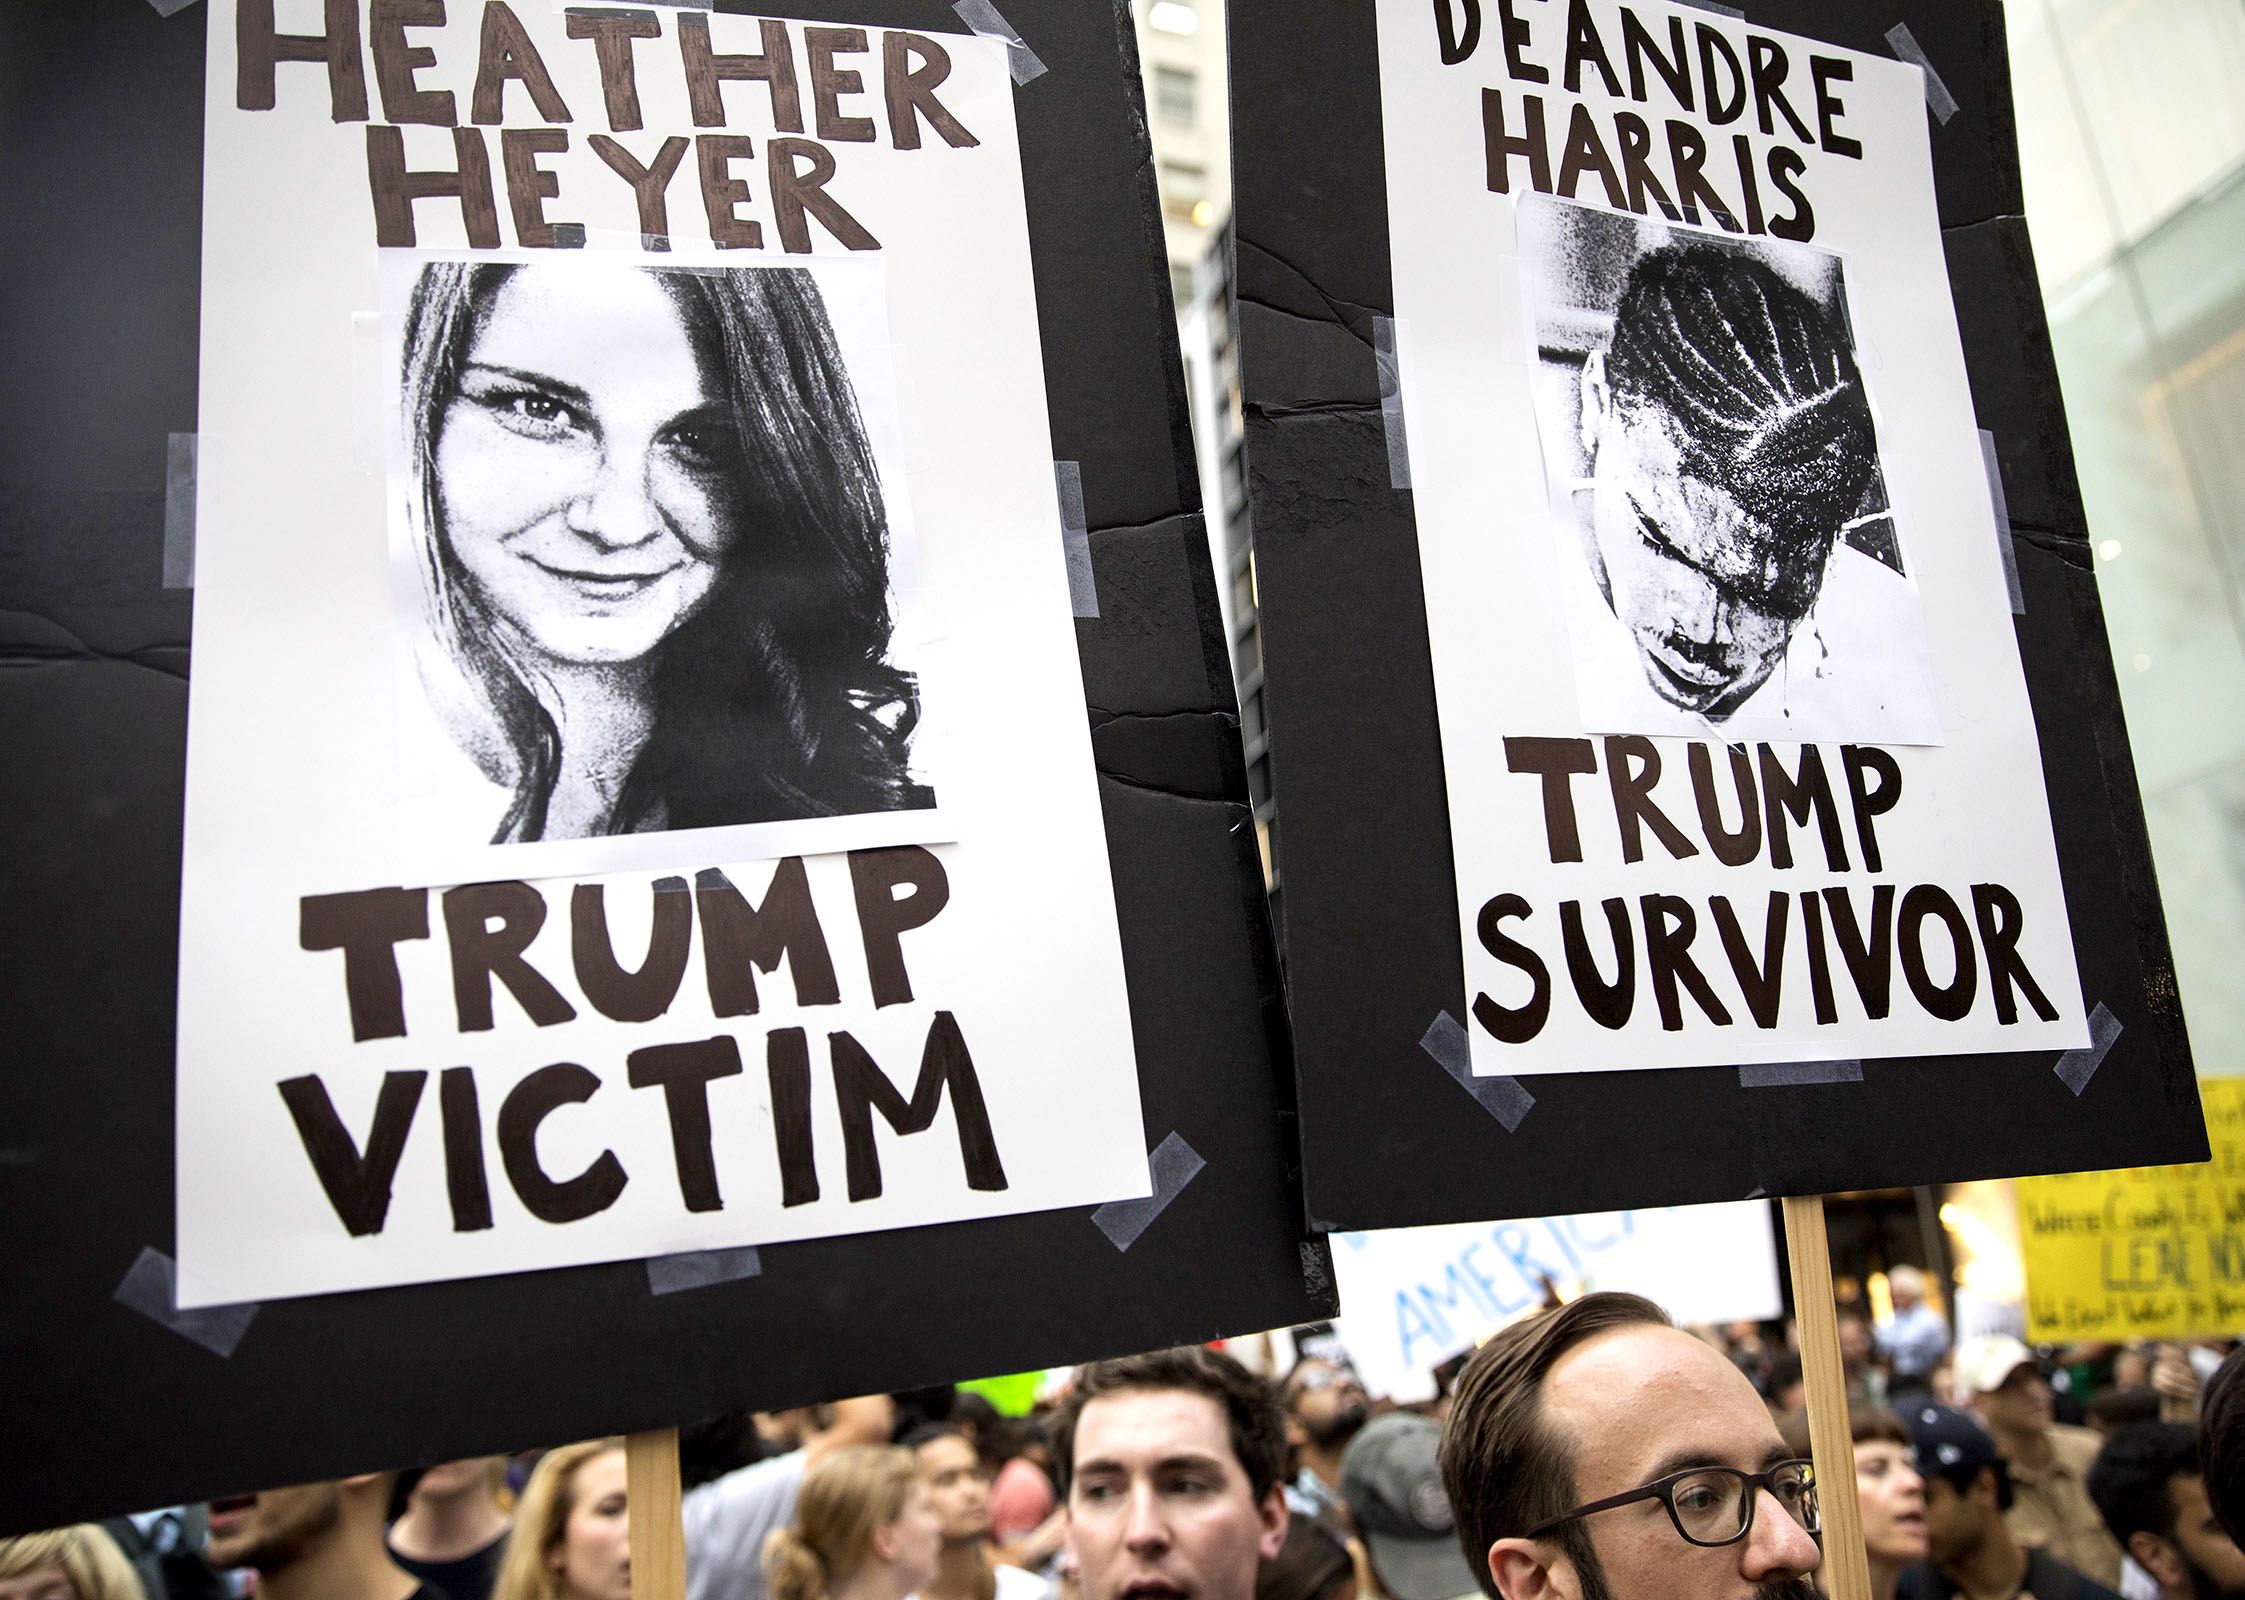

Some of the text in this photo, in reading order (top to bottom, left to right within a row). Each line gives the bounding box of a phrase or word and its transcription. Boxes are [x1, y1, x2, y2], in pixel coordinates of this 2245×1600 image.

[235, 0, 981, 151] HEATHER
[1432, 0, 1862, 160] DEANDRE
[366, 124, 882, 252] HEYER
[1481, 87, 1816, 243] HARRIS
[1503, 735, 1902, 873] TRUMP
[298, 844, 951, 1043] TRUMP
[1471, 882, 2060, 1044] SURVIVOR
[276, 1010, 1009, 1237] VICTIM
[1396, 1210, 1636, 1367] AMERIC
